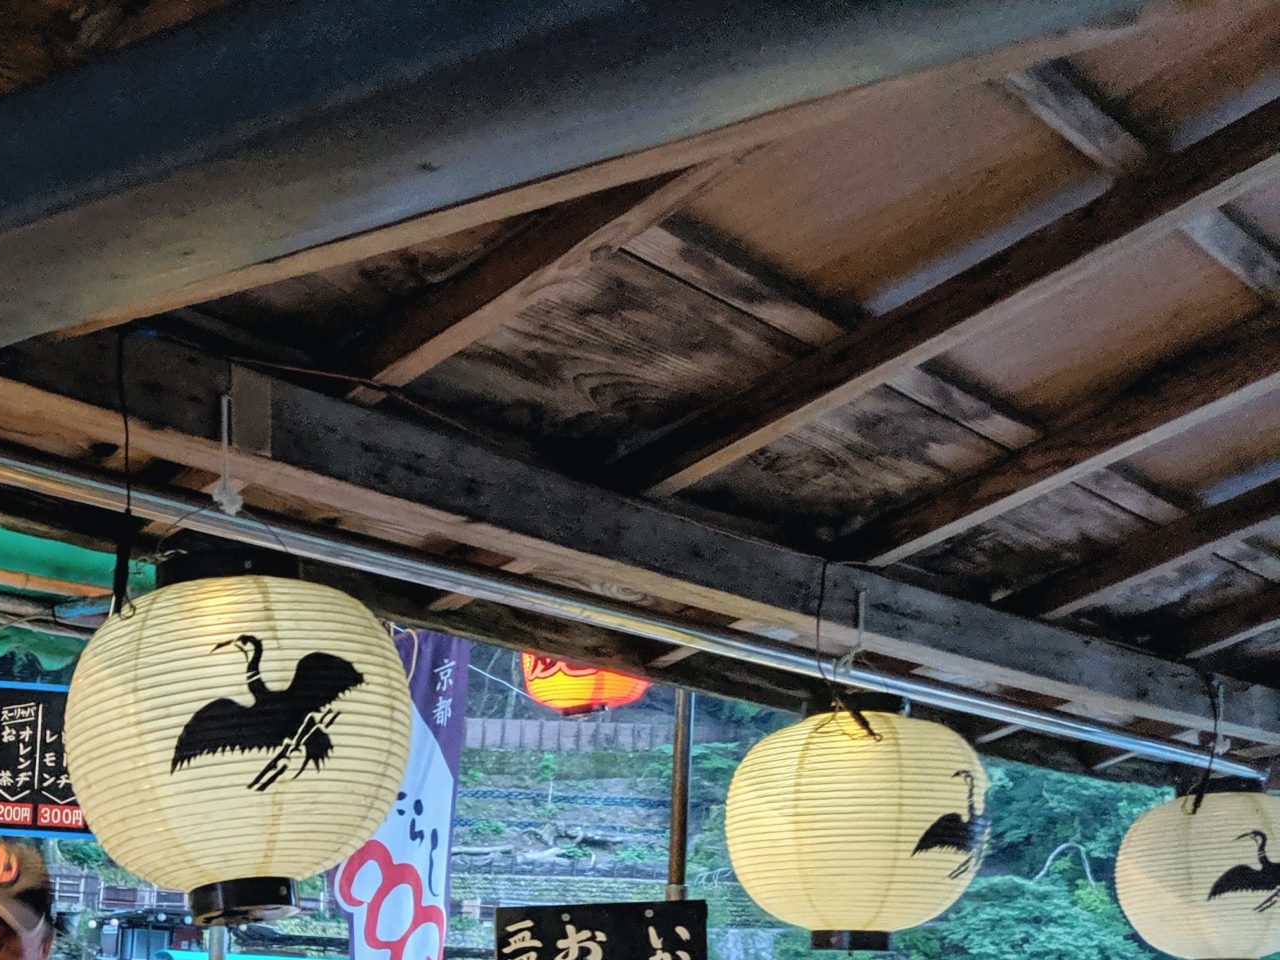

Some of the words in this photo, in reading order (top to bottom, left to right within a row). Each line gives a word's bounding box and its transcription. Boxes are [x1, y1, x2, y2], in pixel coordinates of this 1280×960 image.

[432, 659, 456, 727] 京都
[42, 729, 58, 787] レモン
[41, 807, 83, 825] 300円
